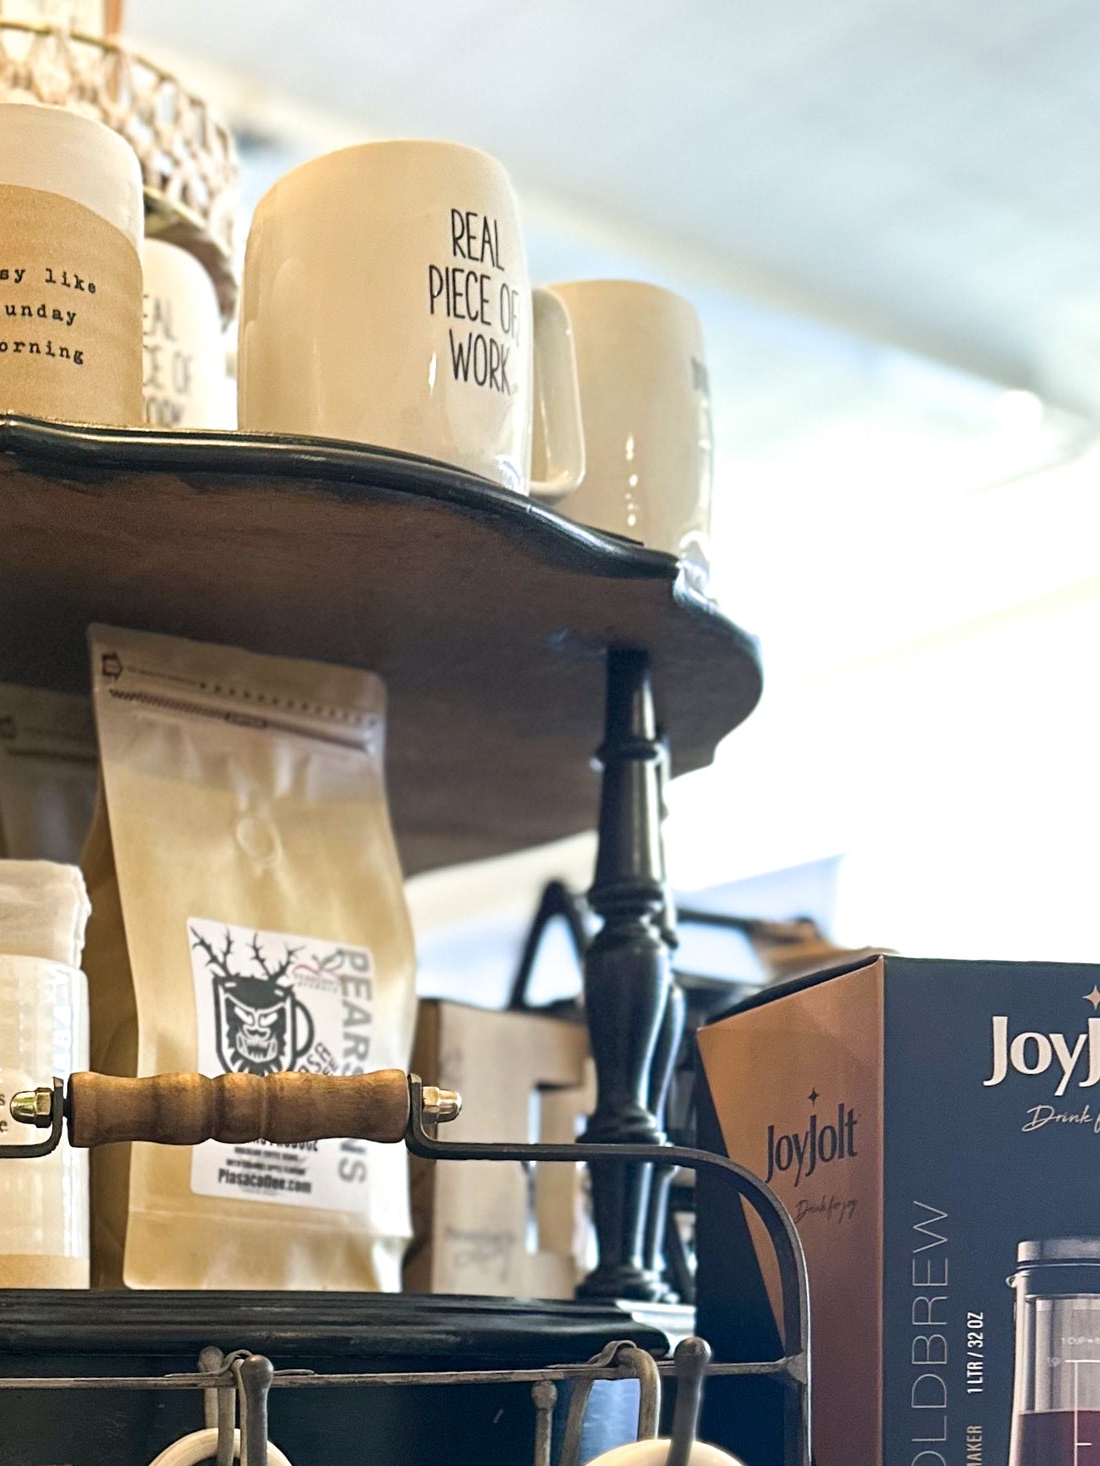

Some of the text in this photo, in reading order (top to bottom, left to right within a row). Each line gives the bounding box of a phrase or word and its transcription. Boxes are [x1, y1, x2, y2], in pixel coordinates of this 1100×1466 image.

[450, 208, 505, 272] REAL
[45, 267, 97, 295] like
[428, 264, 519, 339] PIECE OF
[449, 328, 510, 396] WORK
[1021, 1104, 1094, 1132] Drink
[765, 1103, 858, 1187] JoyJolt
[967, 1311, 984, 1329] OZ
[967, 1332, 984, 1348] 32
[967, 1362, 984, 1385] LTR
